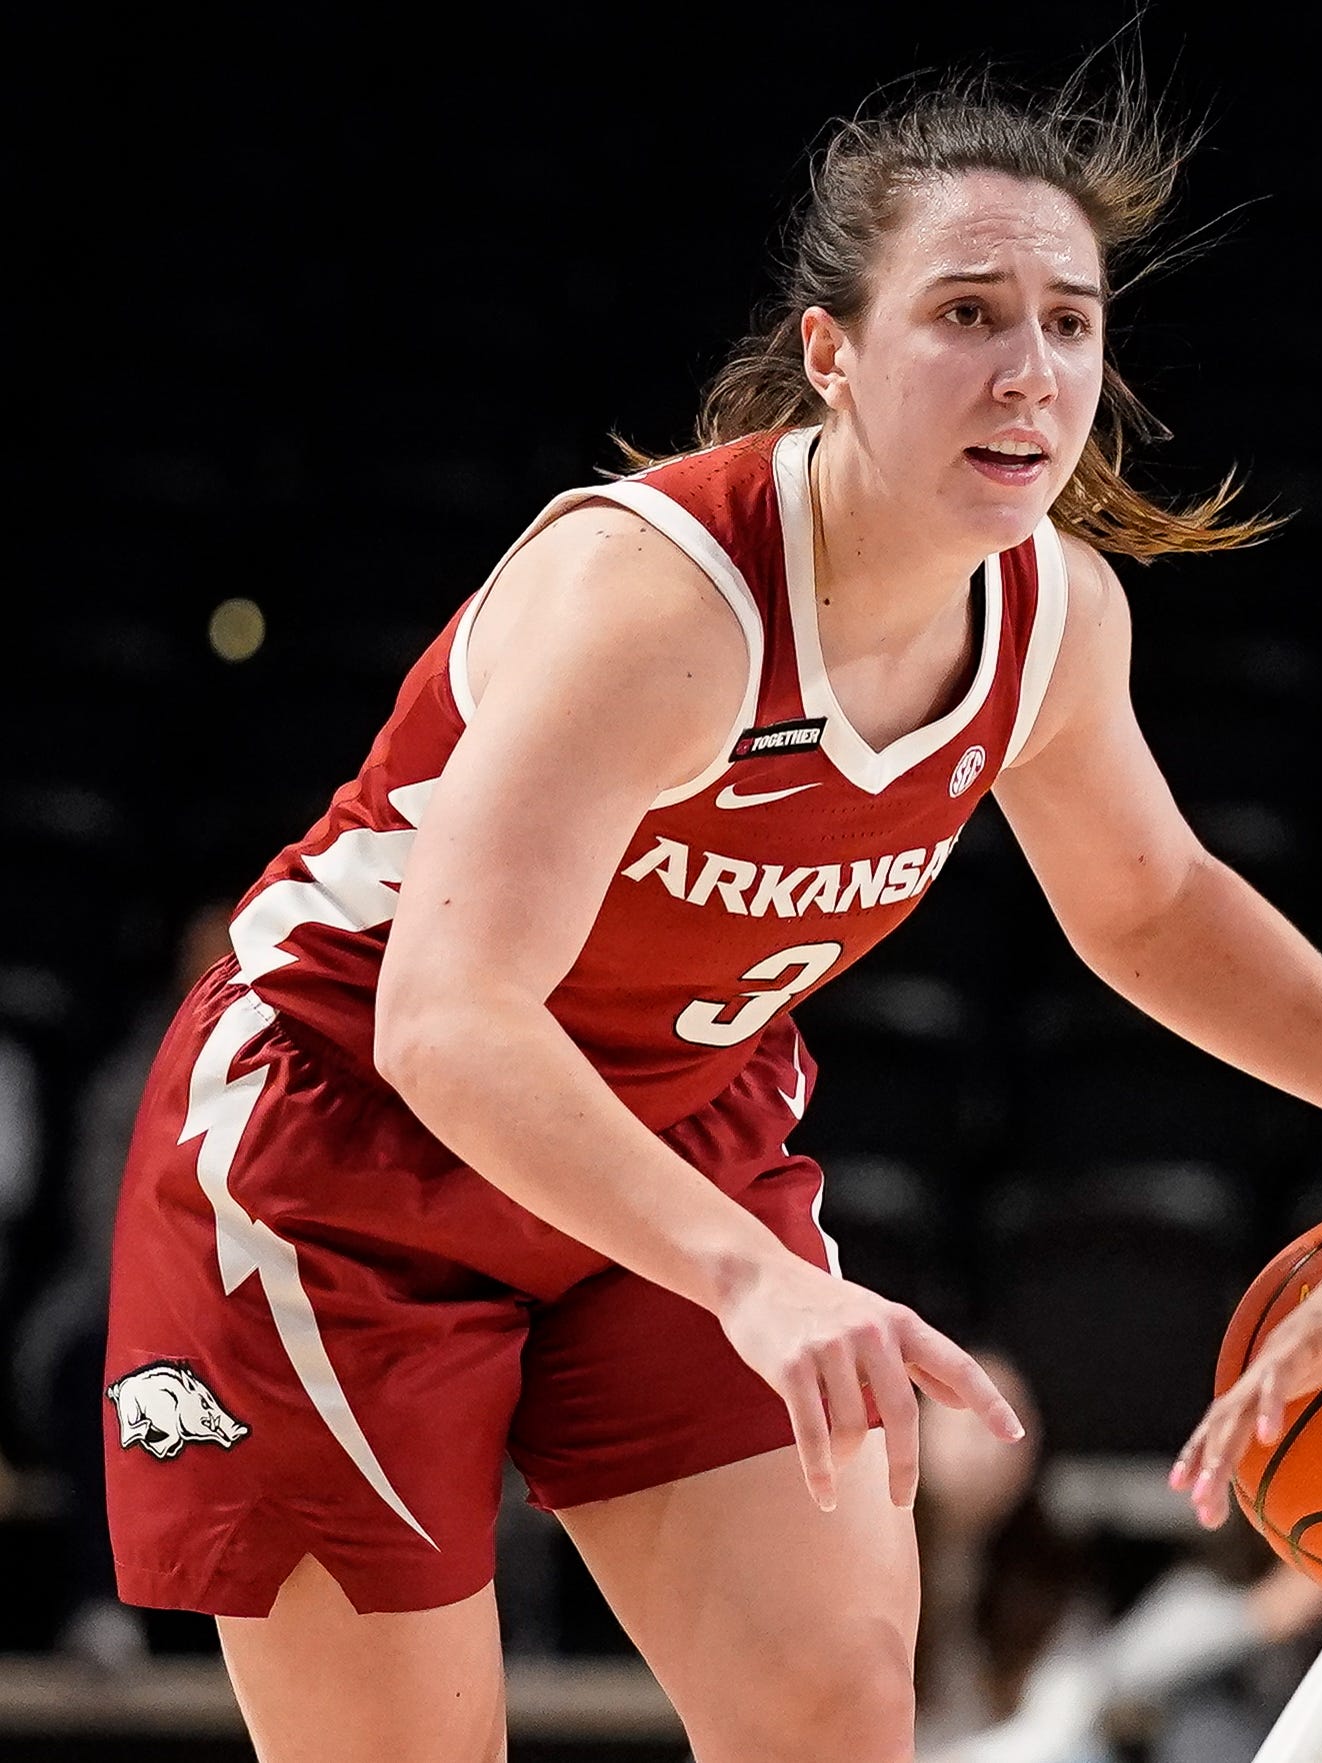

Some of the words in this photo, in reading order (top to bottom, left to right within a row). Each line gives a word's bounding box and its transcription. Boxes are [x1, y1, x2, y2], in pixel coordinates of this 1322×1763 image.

[750, 727, 821, 753] TOGETHER
[621, 822, 965, 918] ARKANSA
[675, 941, 842, 1047] 3
